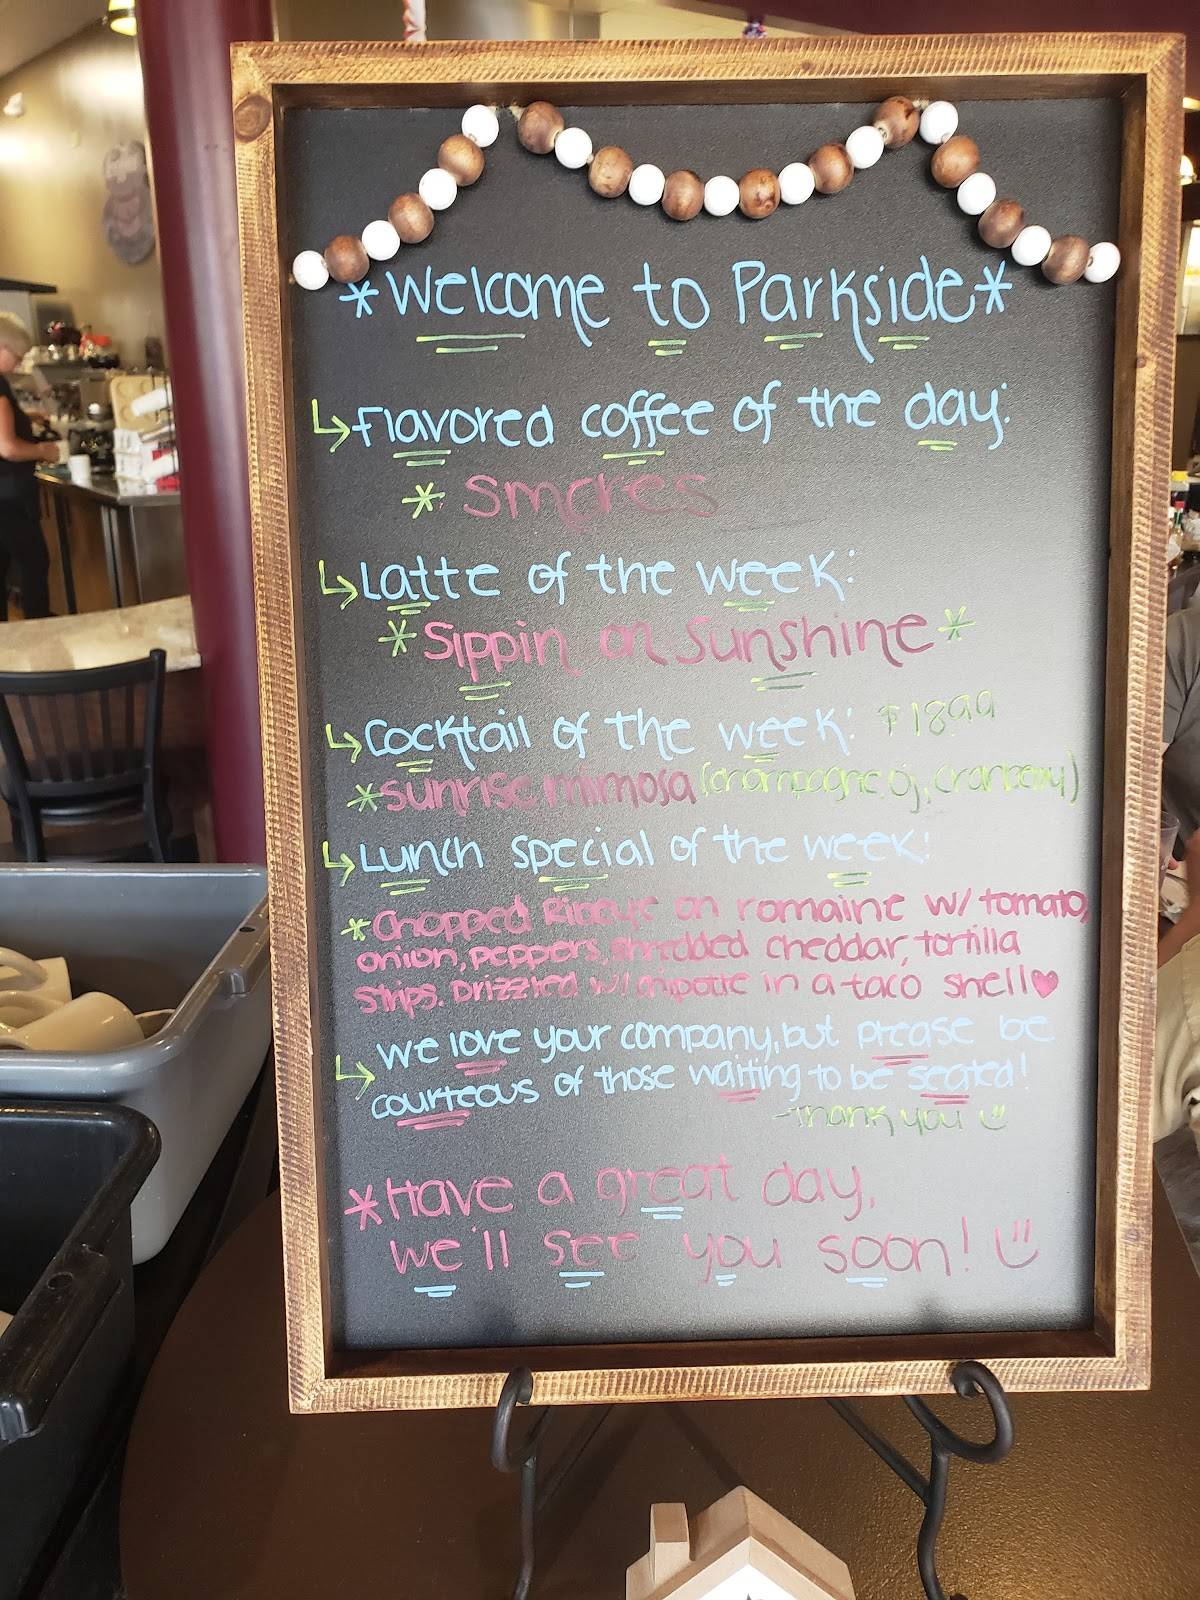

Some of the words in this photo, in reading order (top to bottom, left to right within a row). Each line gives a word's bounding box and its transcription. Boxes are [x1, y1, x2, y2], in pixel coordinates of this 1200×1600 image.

[385, 264, 609, 347] Welcome
[632, 261, 710, 329] to
[732, 254, 975, 364] Parkside
[352, 404, 554, 447] Flavored
[581, 388, 714, 448] coffee
[732, 380, 782, 444] of
[797, 387, 881, 428] the
[904, 381, 1011, 450] day:
[360, 554, 500, 600] Latte
[528, 551, 572, 605] of
[585, 553, 675, 596] the
[695, 549, 856, 601] week:
[423, 619, 582, 682] Sippin
[600, 620, 669, 666] on
[675, 613, 934, 672] Sunshine
[552, 711, 590, 759] of
[604, 707, 696, 760] the
[718, 706, 855, 756] week:
[359, 834, 484, 877] Lunch
[512, 826, 655, 874] special
[671, 826, 706, 866] of
[712, 824, 788, 864] the
[675, 896, 720, 920] on
[736, 894, 905, 924] romaine
[924, 887, 972, 917] w/
[978, 887, 1089, 925] tomato,
[356, 945, 466, 973] onion,
[765, 931, 908, 967] cheddar,
[914, 923, 1022, 957] tortilla
[764, 971, 799, 993] in
[812, 972, 836, 997] a
[841, 971, 922, 1000] taco
[944, 964, 1028, 999] shell
[449, 1026, 521, 1057] love
[534, 1023, 611, 1063] your
[782, 1014, 839, 1048] but
[857, 1015, 975, 1049] please
[999, 1015, 1055, 1042] be
[371, 1079, 539, 1119] courteous
[554, 1066, 584, 1097] of
[593, 1062, 675, 1094] those
[688, 1055, 801, 1101] waiting
[808, 1062, 842, 1091] to
[849, 1063, 893, 1090] be
[908, 1053, 1030, 1091] seated!
[900, 1107, 963, 1136] you
[386, 1174, 513, 1220] Have
[538, 1171, 574, 1206] a
[597, 1153, 739, 1216] great
[544, 1230, 640, 1267] see
[683, 1231, 781, 1284] you
[817, 1215, 970, 1276] soon!
